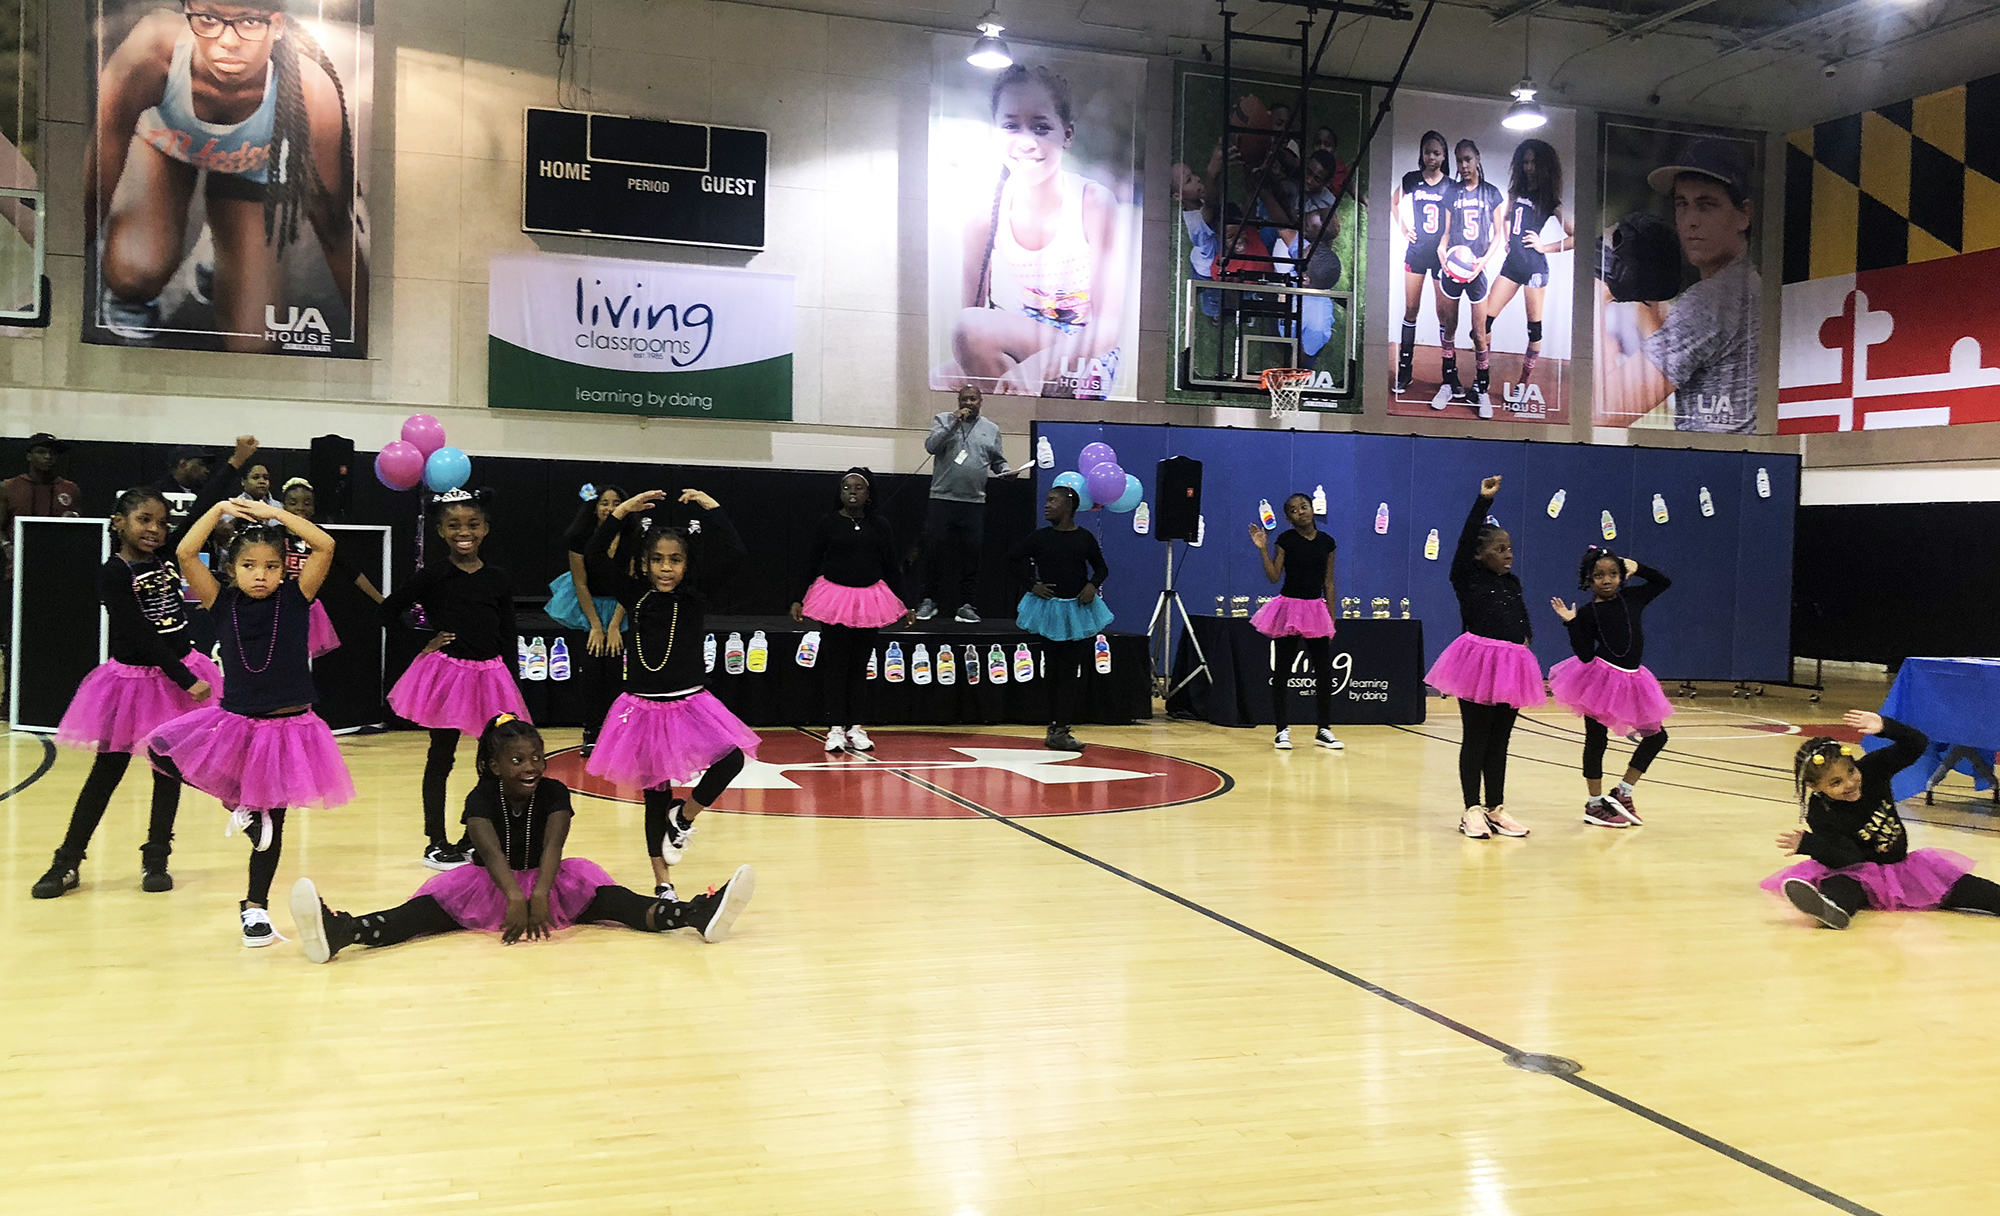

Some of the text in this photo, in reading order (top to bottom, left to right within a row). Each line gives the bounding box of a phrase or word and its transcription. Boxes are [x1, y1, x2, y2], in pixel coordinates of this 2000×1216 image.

[539, 160, 592, 181] HOME
[628, 178, 670, 194] PERIOD
[701, 175, 757, 196] GUEST
[1423, 203, 1440, 234] 3
[1463, 209, 1480, 241] 5
[1512, 206, 1524, 235] 1
[265, 304, 331, 333] UA
[576, 277, 714, 367] living
[264, 331, 331, 345] HOUSE
[575, 330, 691, 354] classrooms
[1060, 356, 1108, 381] UA
[1060, 378, 1110, 391] HOUSE
[1503, 381, 1546, 405] UA
[576, 387, 713, 410] learning by doing
[1503, 402, 1546, 413] HOUSE
[1697, 394, 1734, 415] UA
[1699, 414, 1735, 424] OUSE
[1349, 679, 1388, 690] learning
[1348, 691, 1388, 702] by doing
